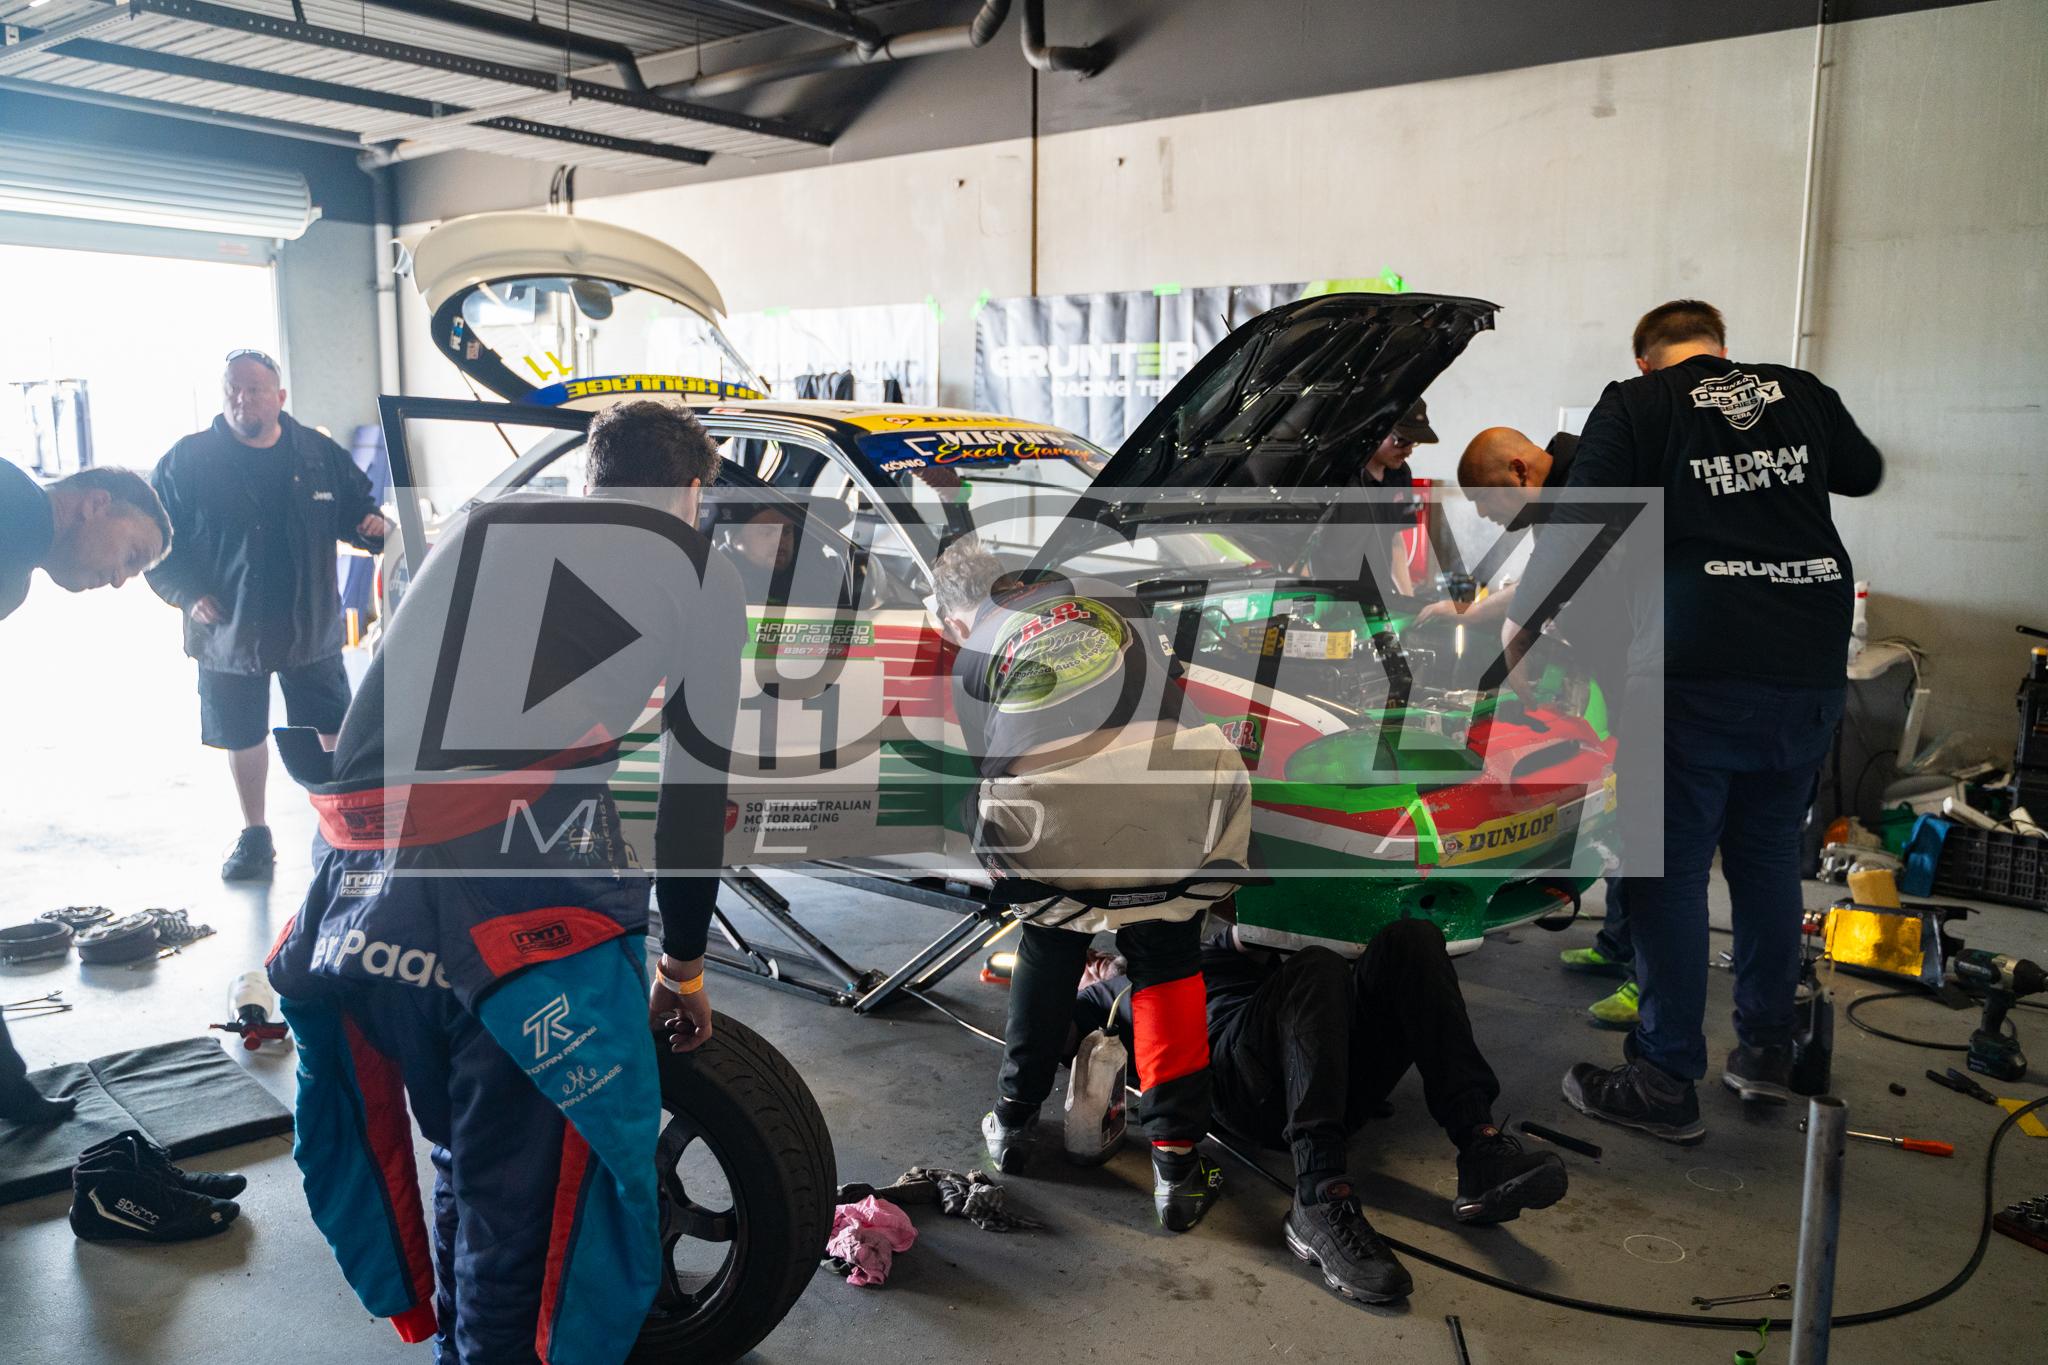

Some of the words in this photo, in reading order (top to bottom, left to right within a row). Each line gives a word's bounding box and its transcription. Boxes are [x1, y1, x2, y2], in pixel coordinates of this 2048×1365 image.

[989, 342, 1198, 378] GRUNTER
[1054, 380, 1130, 398] RACING
[1715, 377, 1750, 391] DUNLO
[934, 441, 1007, 465] Excel
[1690, 455, 1731, 479] THE
[1734, 445, 1809, 471] DREAM
[880, 457, 929, 474] KÖNIG
[1705, 469, 1772, 496] TEAM
[1704, 557, 1840, 577] GRUNTER
[1771, 576, 1814, 584] RACING
[1815, 572, 1842, 583] TEAM
[755, 622, 870, 636] HAMPSTEAD
[755, 633, 796, 643] AUTO
[801, 634, 870, 645] REPAIRS
[1053, 659, 1081, 673] Auto
[740, 682, 840, 770] 11
[746, 802, 790, 813] SOUTH
[791, 800, 871, 813] AUSTRALIAN
[744, 814, 791, 825] MOTOR
[793, 813, 839, 824] RACING
[1466, 813, 1555, 853] DUNLOP
[588, 1064, 623, 1096] MIRAGE
